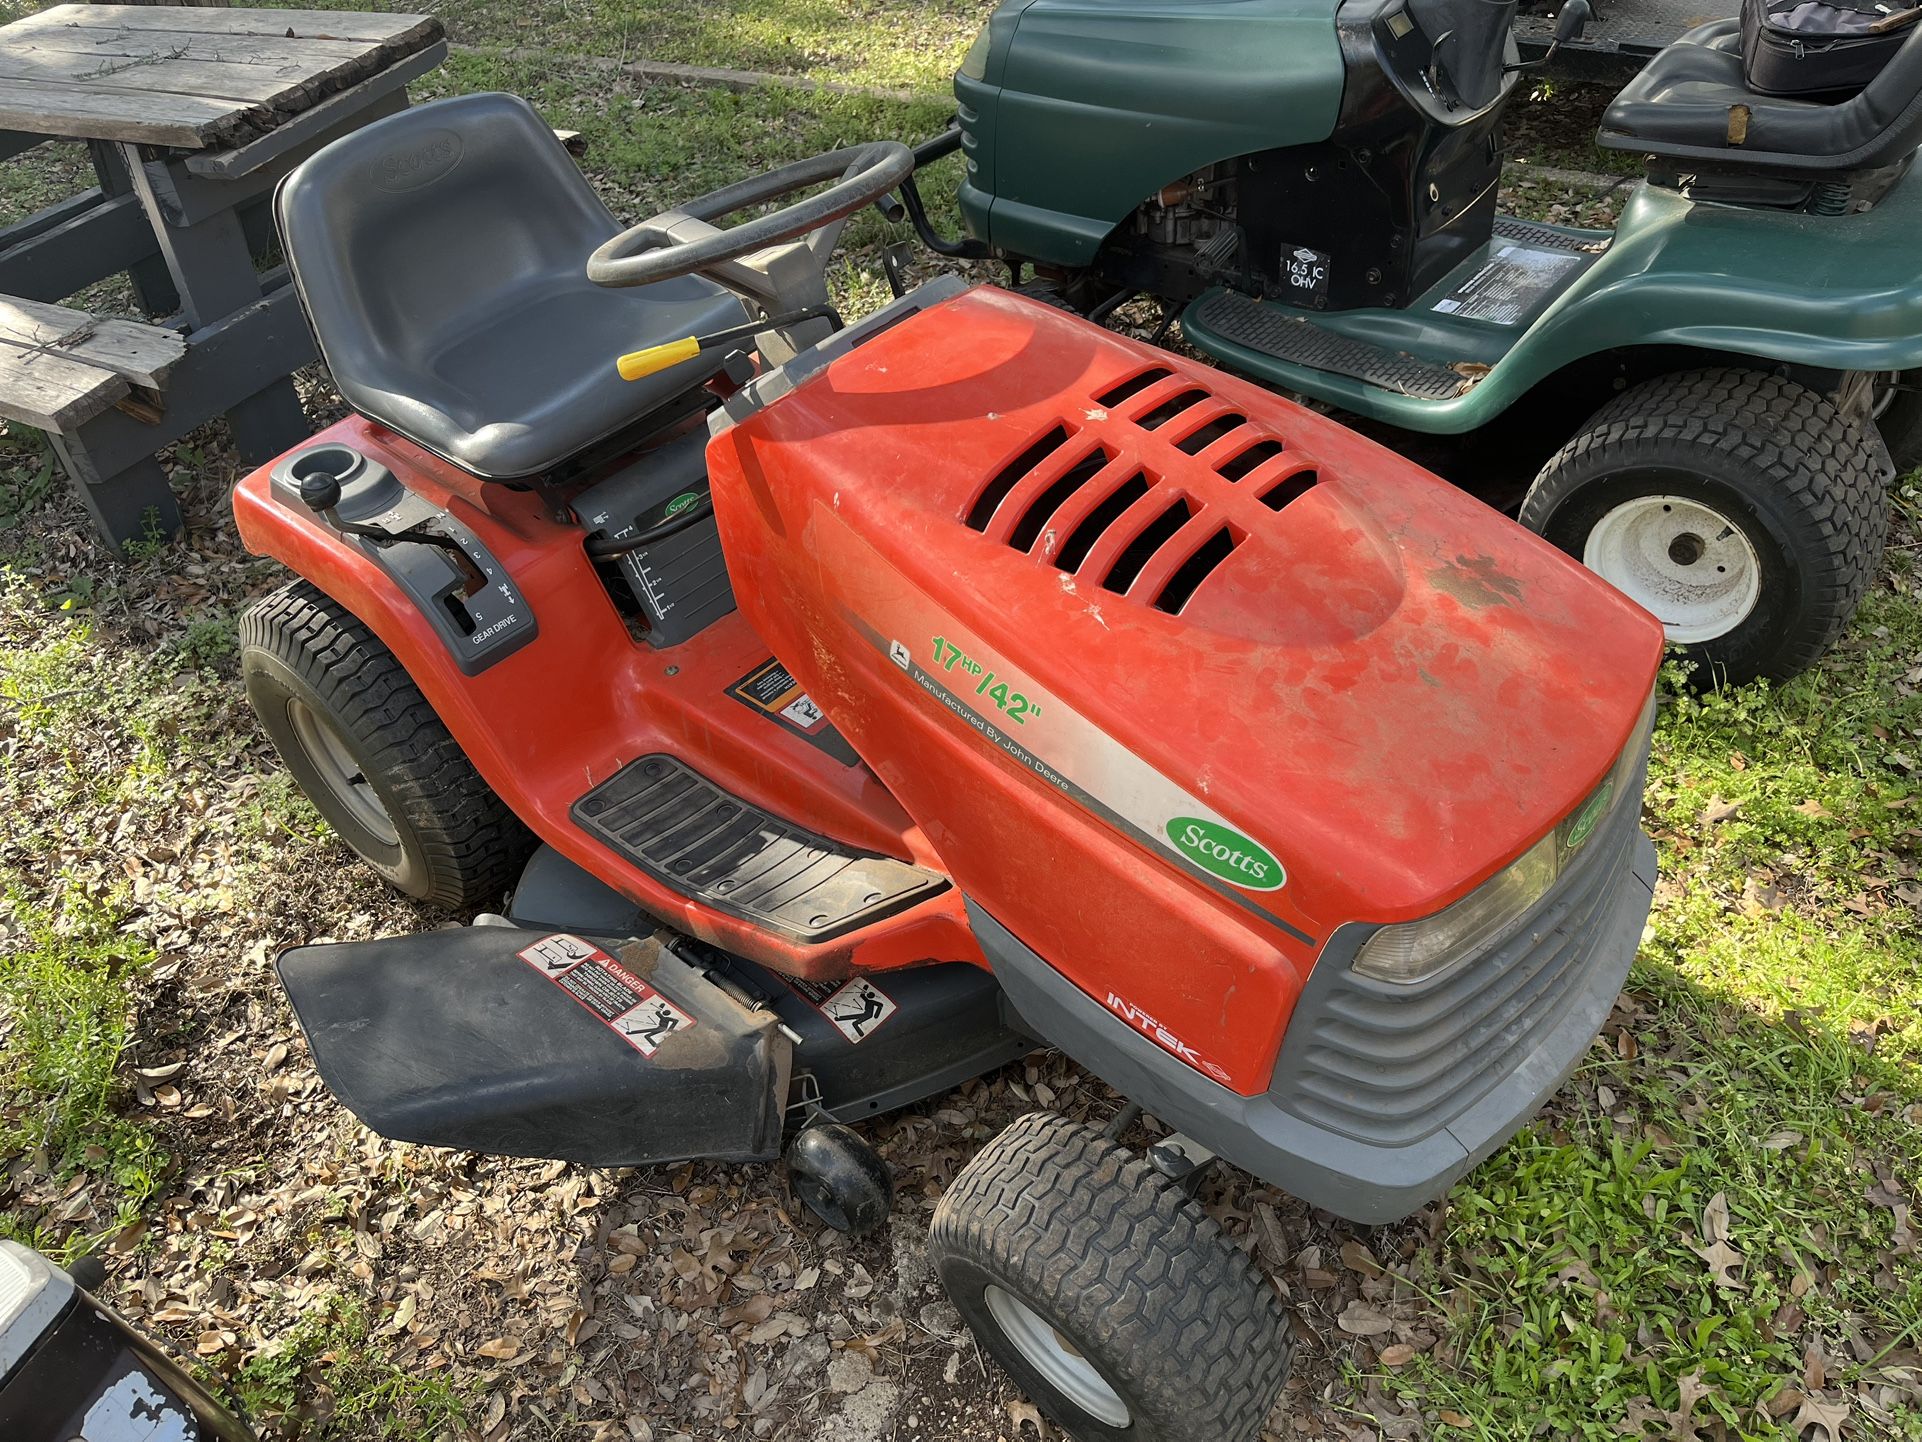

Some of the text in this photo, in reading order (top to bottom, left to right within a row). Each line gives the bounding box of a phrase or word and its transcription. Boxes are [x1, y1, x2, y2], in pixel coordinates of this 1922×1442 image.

[1286, 260, 1324, 279] 16.5 IC
[1291, 274, 1317, 289] OHV
[460, 537, 469, 545] 2
[473, 551, 481, 559] 3
[486, 567, 493, 575] 4
[475, 612, 483, 621] 5
[472, 614, 517, 645] GEAR DRIVE
[913, 670, 1069, 790] Manufactured By John Deere
[1180, 824, 1269, 879] Scotts
[607, 963, 646, 993] DANGER
[1107, 991, 1201, 1065] INTEK
